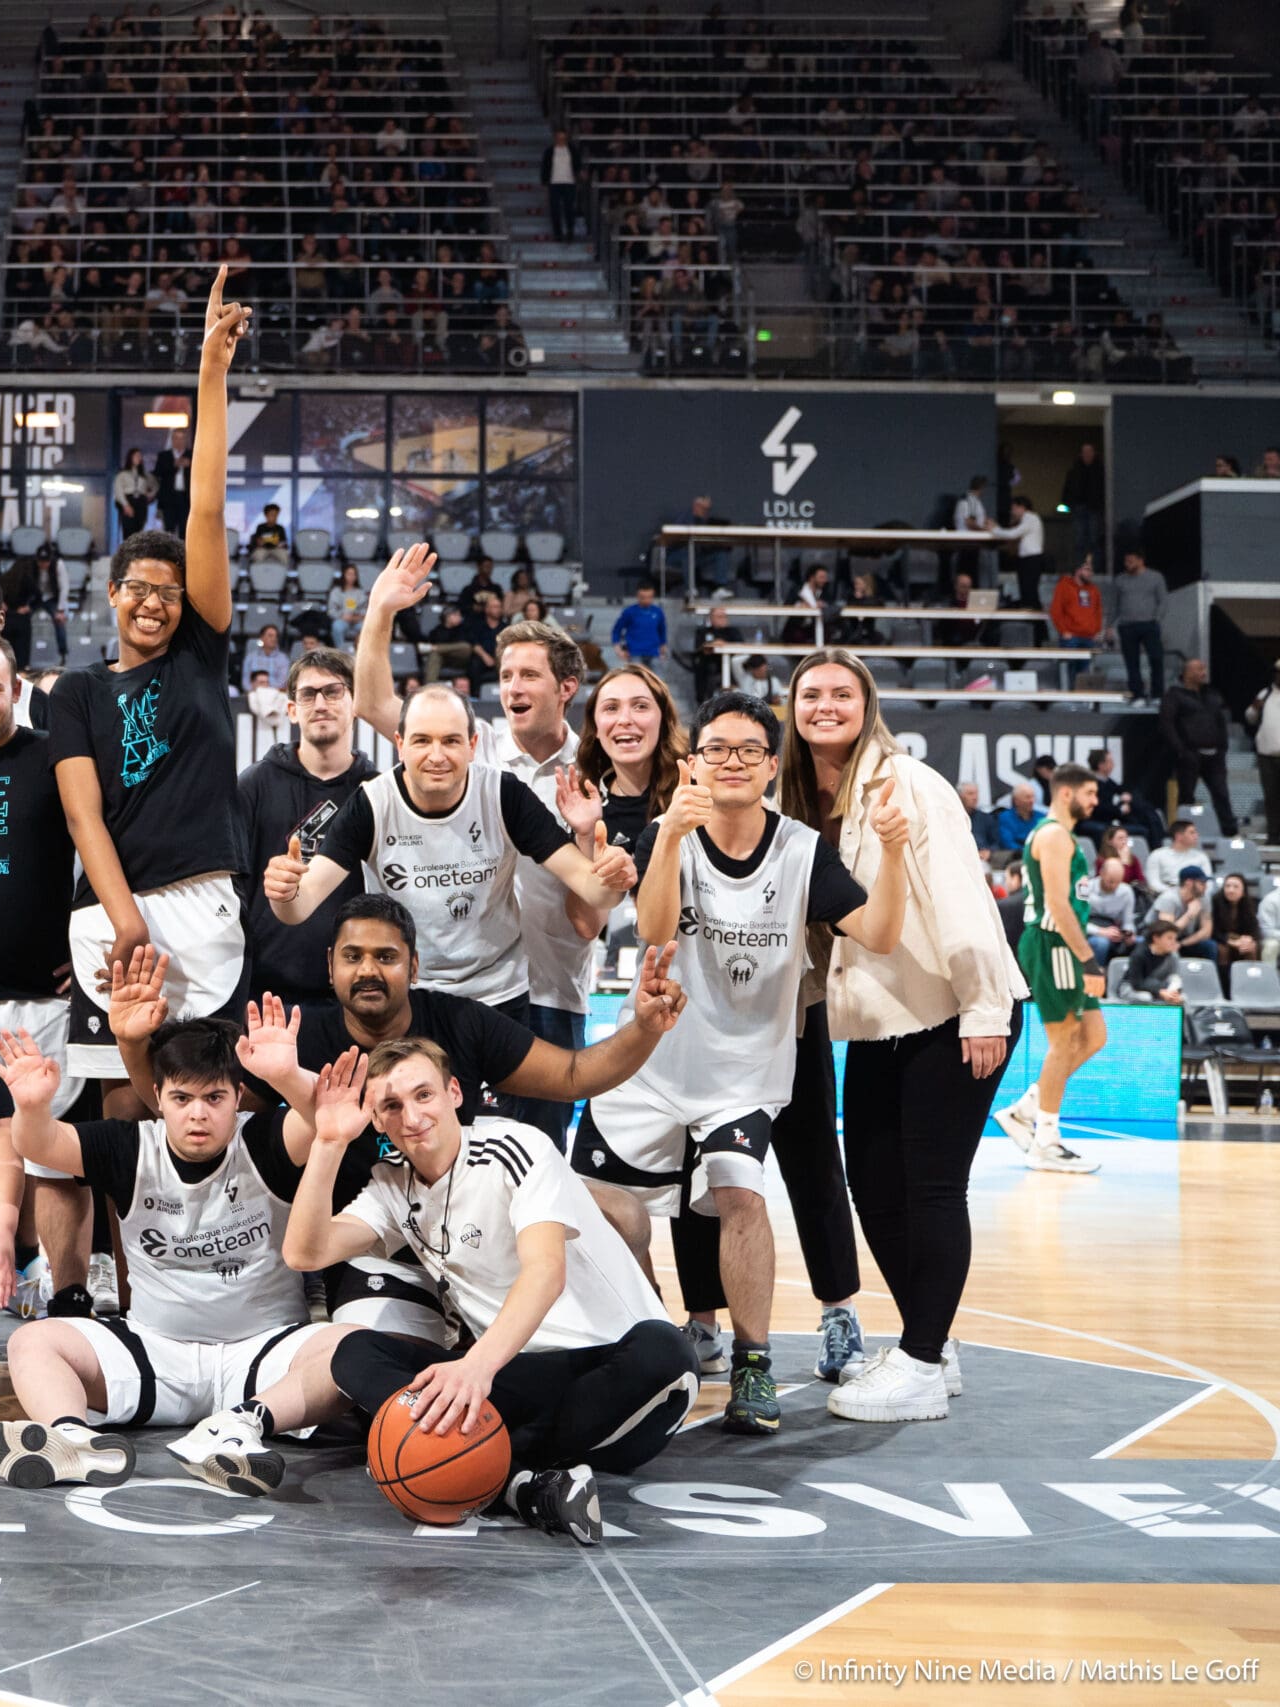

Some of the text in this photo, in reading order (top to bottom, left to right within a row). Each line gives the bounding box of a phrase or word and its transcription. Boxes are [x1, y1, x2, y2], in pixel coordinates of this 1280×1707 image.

[763, 499, 816, 518] LDLC
[413, 862, 460, 873] Euroleague
[414, 865, 498, 889] oneteam
[704, 913, 748, 929] Euroleague
[703, 925, 788, 948] oneteam
[171, 1228, 222, 1244] Euroleague
[173, 1221, 271, 1258] oneteam
